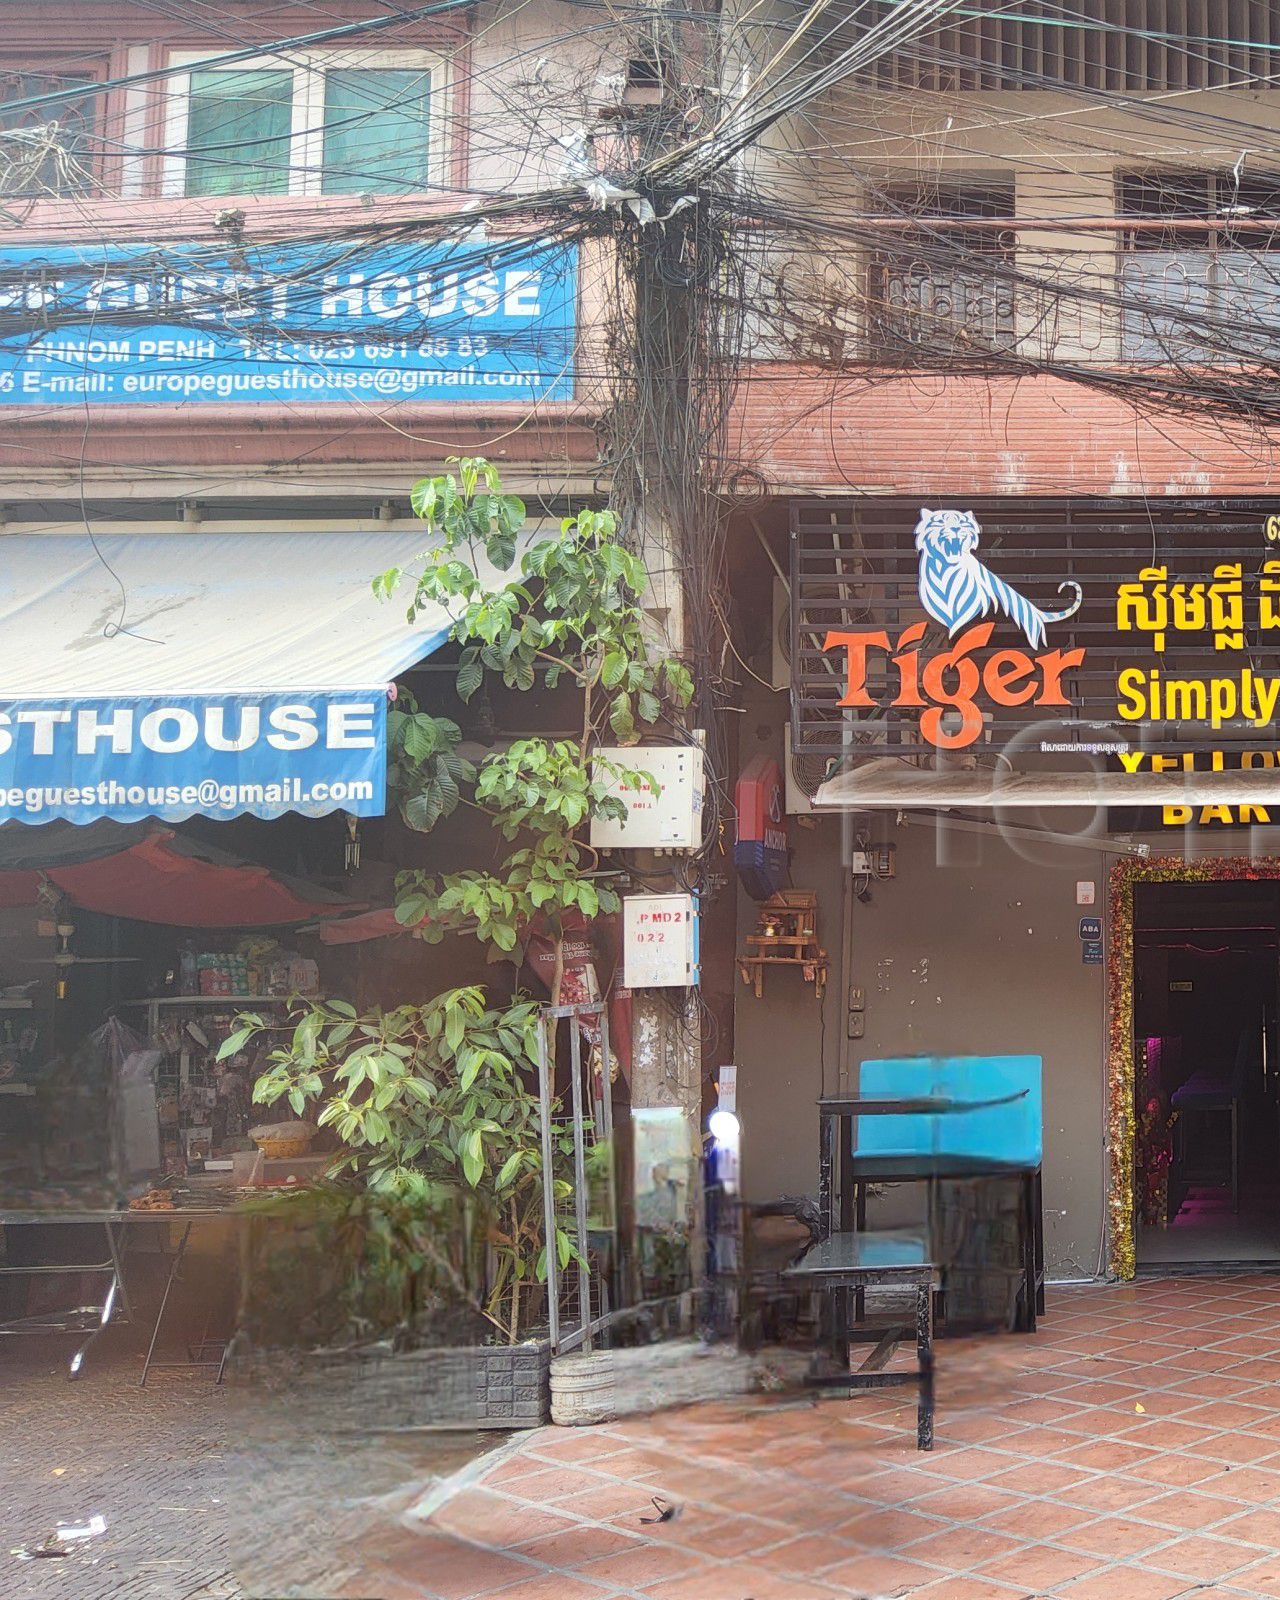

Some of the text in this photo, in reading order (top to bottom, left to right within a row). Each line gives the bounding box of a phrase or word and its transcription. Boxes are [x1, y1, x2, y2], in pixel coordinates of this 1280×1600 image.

[320, 270, 541, 319] HOUSE
[26, 340, 130, 363] PHNOM
[139, 341, 215, 361] PENH
[23, 373, 113, 393] E-mail:
[123, 366, 541, 396] europeguesthouse@gmail.com
[822, 621, 1086, 750] Tiger
[0, 703, 376, 756] THOUSE
[1163, 804, 1271, 825] BAR
[1082, 925, 1099, 933] ABA
